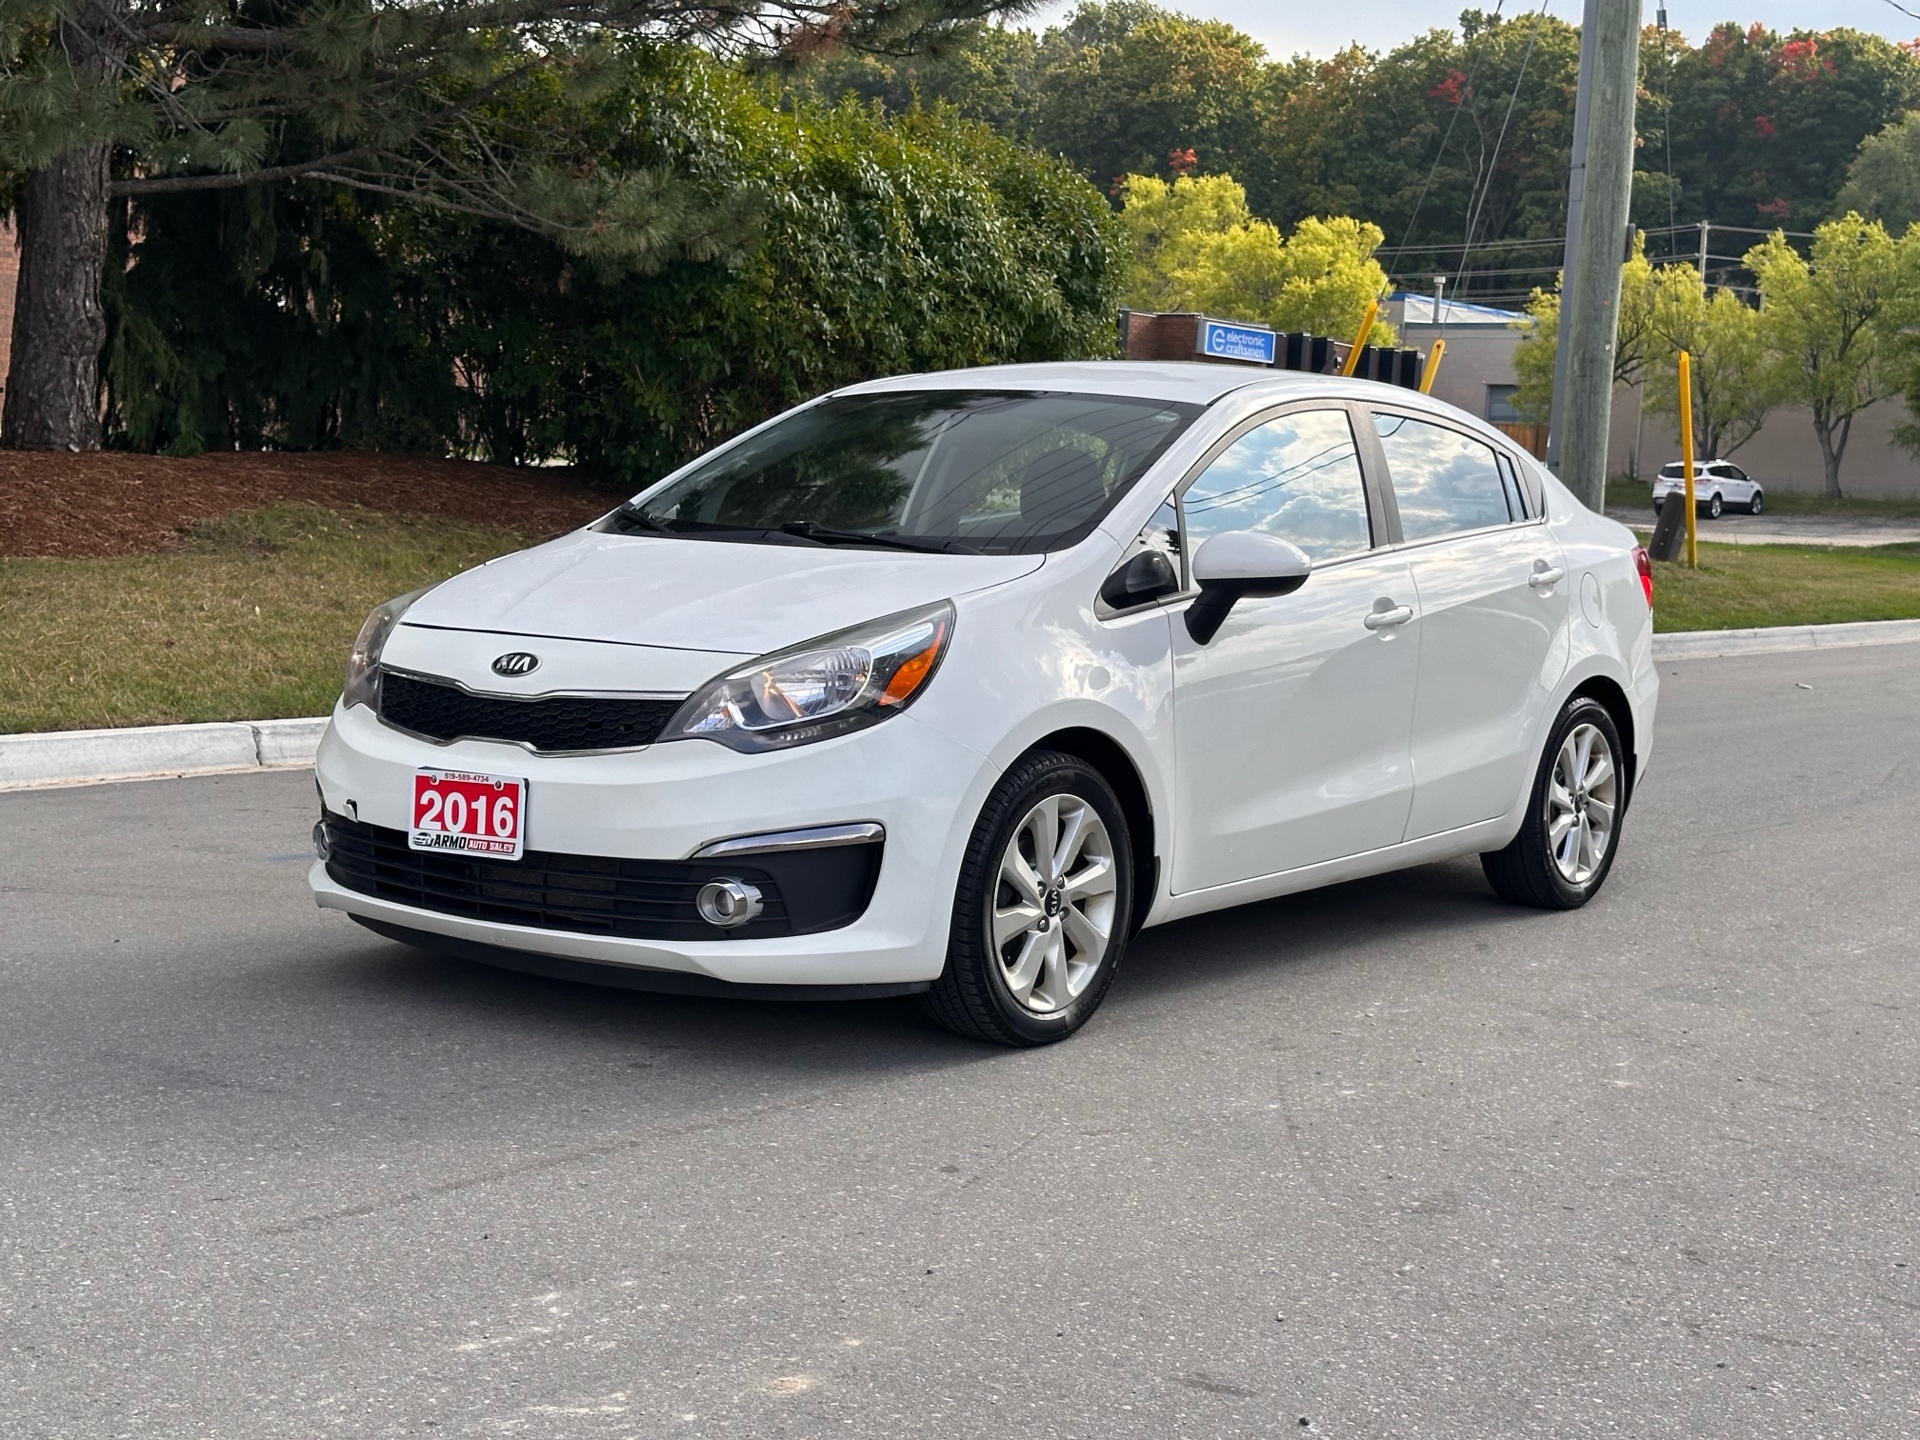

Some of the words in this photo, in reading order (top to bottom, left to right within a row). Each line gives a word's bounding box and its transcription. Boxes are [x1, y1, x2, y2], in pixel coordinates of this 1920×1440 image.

[1226, 331, 1265, 347] electronic
[1225, 344, 1265, 358] craftsmen
[495, 654, 531, 671] KIA
[418, 789, 514, 837] 2016
[433, 834, 466, 849] ARMO
[468, 840, 488, 850] AUTO
[489, 841, 514, 853] SALES
